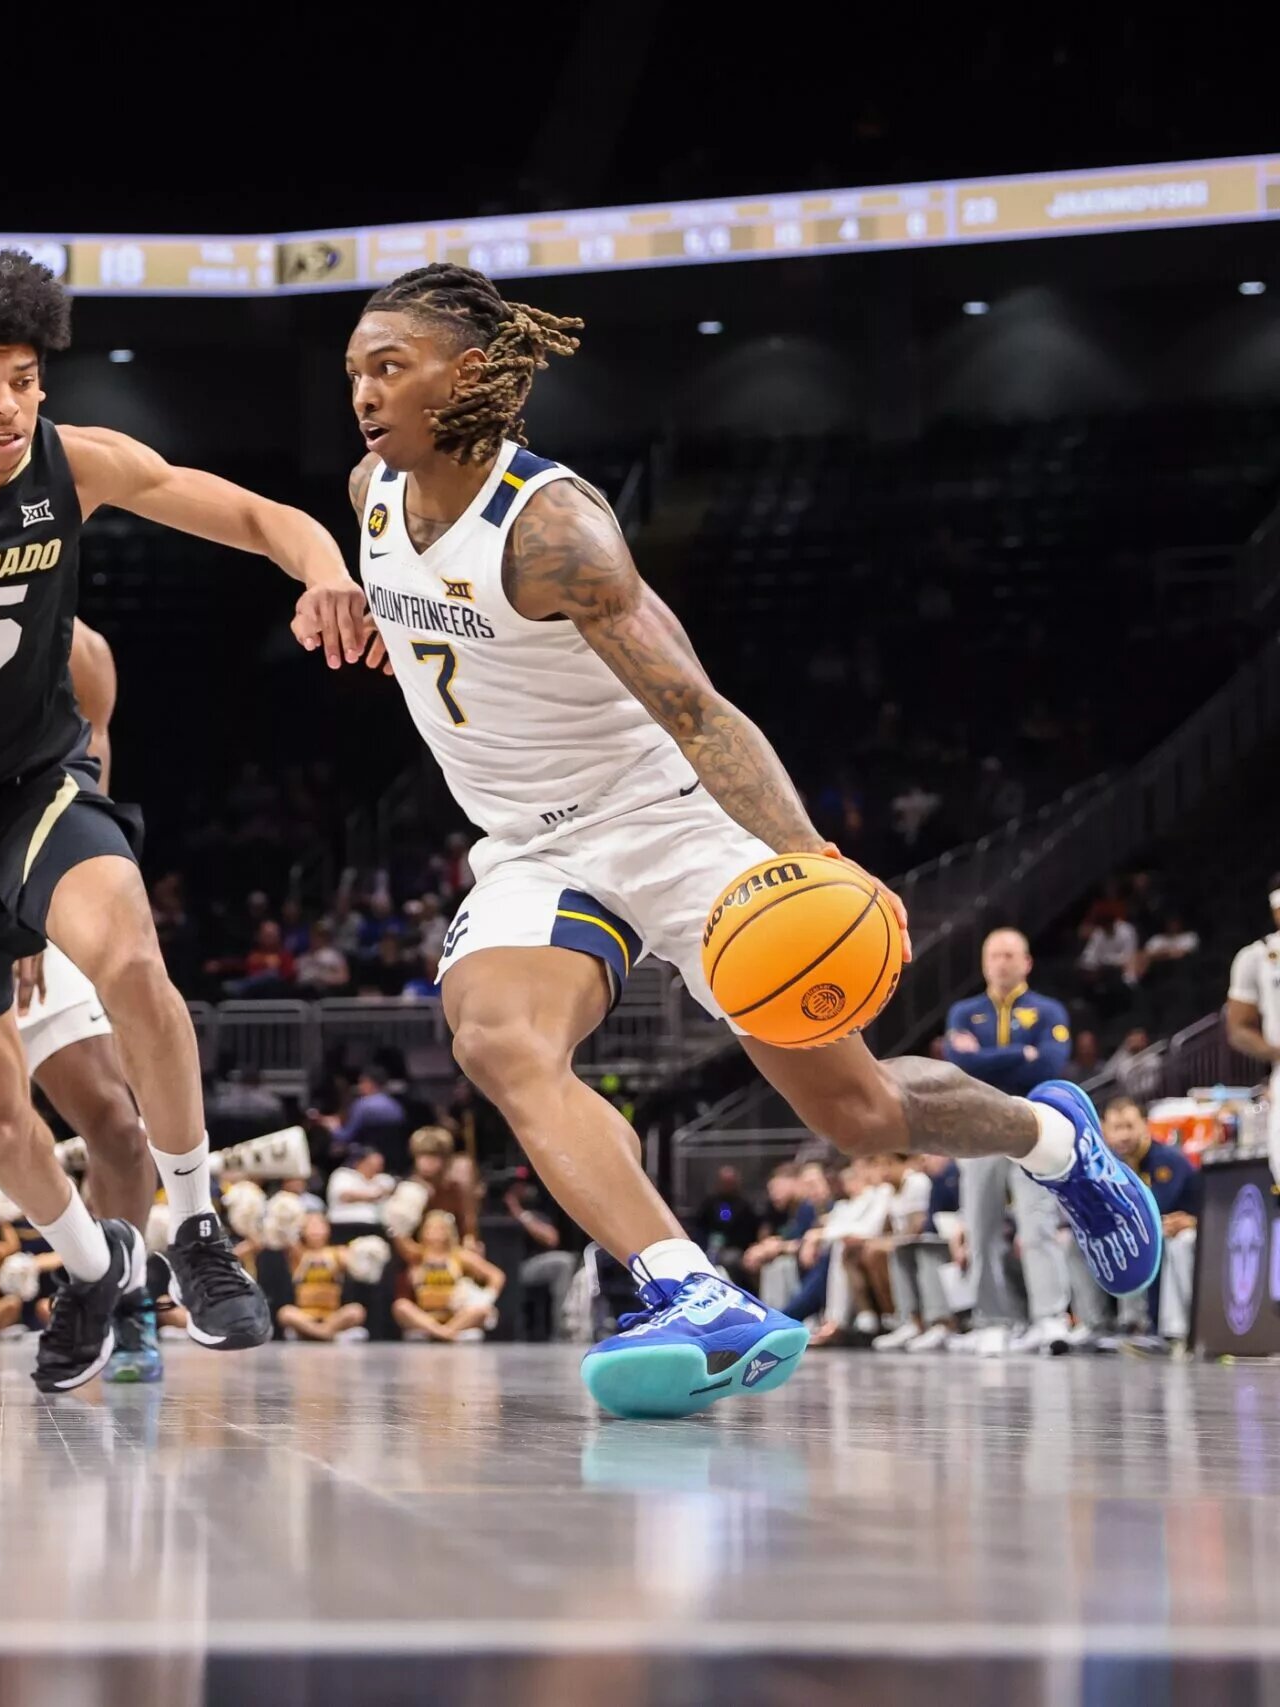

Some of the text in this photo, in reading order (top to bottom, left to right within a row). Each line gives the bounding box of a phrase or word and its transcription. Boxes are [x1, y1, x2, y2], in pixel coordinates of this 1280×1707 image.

[368, 583, 496, 639] MOUNTAINEERS
[410, 640, 468, 727] 7
[703, 863, 807, 948] Wilson
